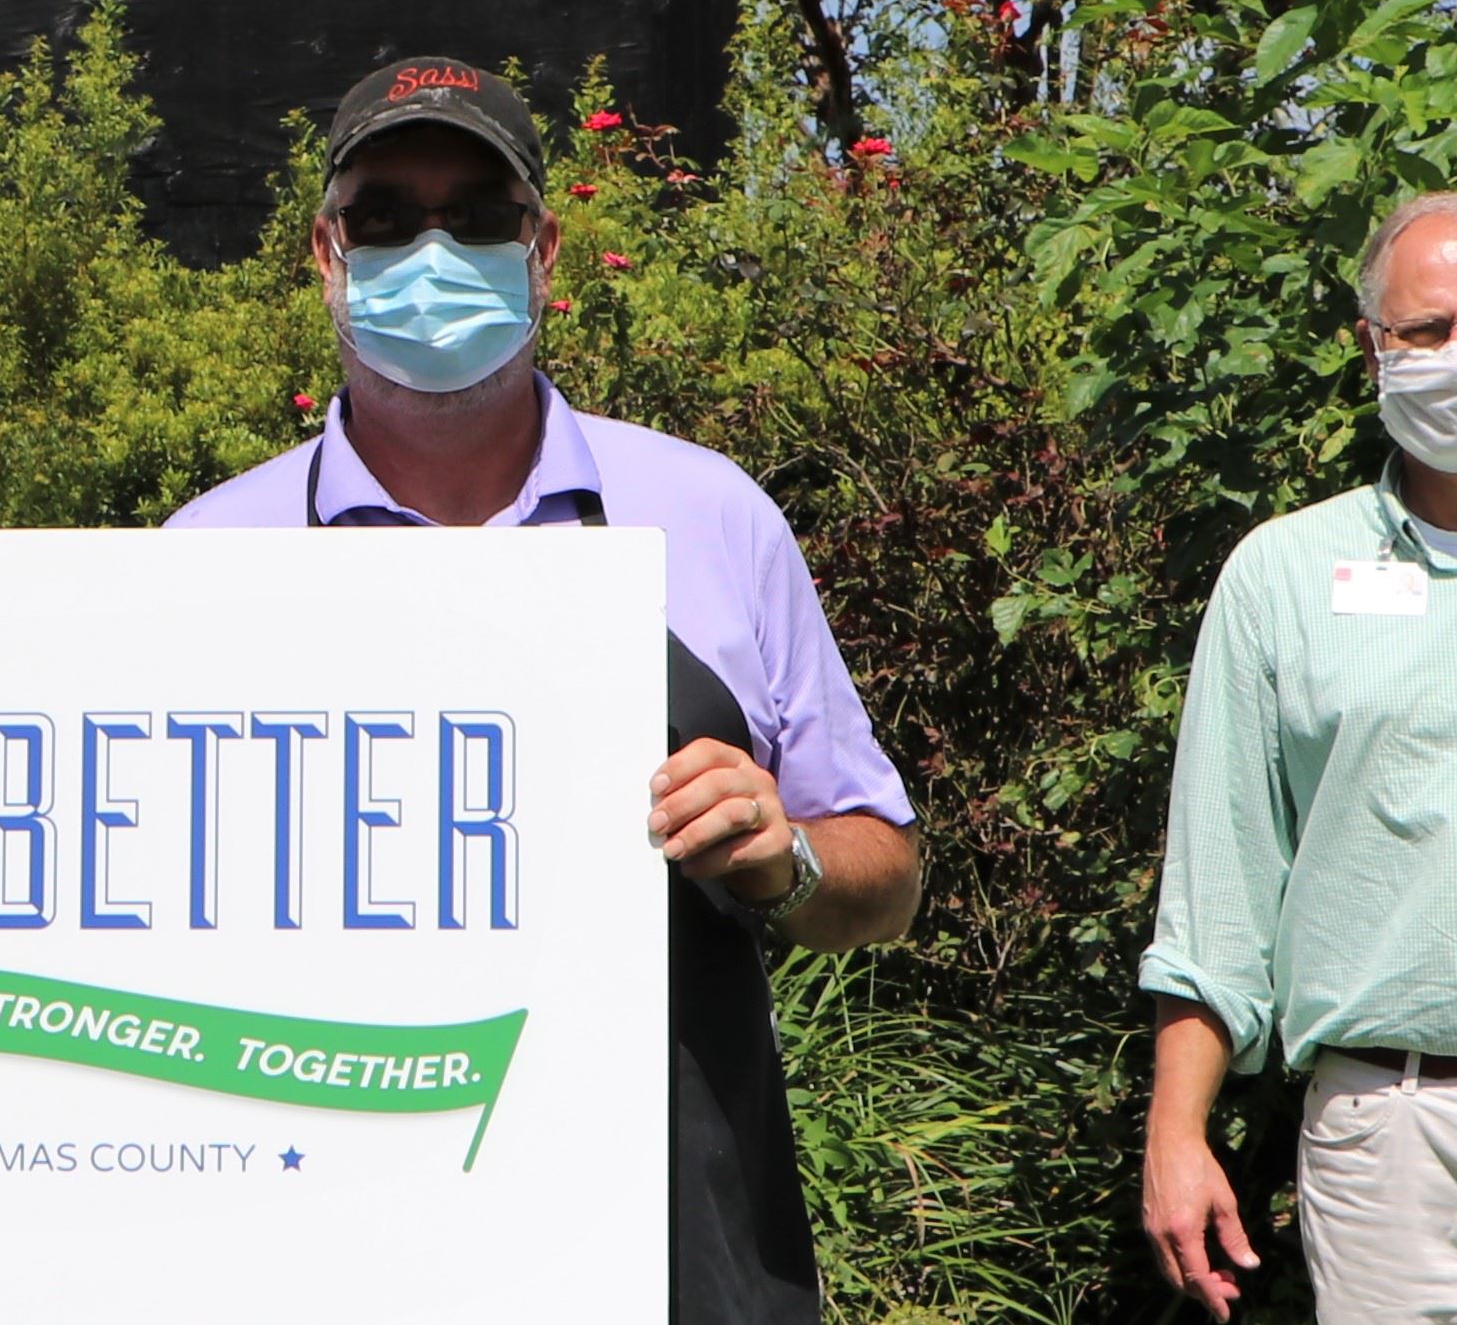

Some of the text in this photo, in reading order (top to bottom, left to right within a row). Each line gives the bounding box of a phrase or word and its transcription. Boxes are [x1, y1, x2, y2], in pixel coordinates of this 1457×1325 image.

[388, 65, 479, 103] Sass!
[236, 1037, 482, 1091] TOGETHER.
[89, 1142, 257, 1174] COUNTY
